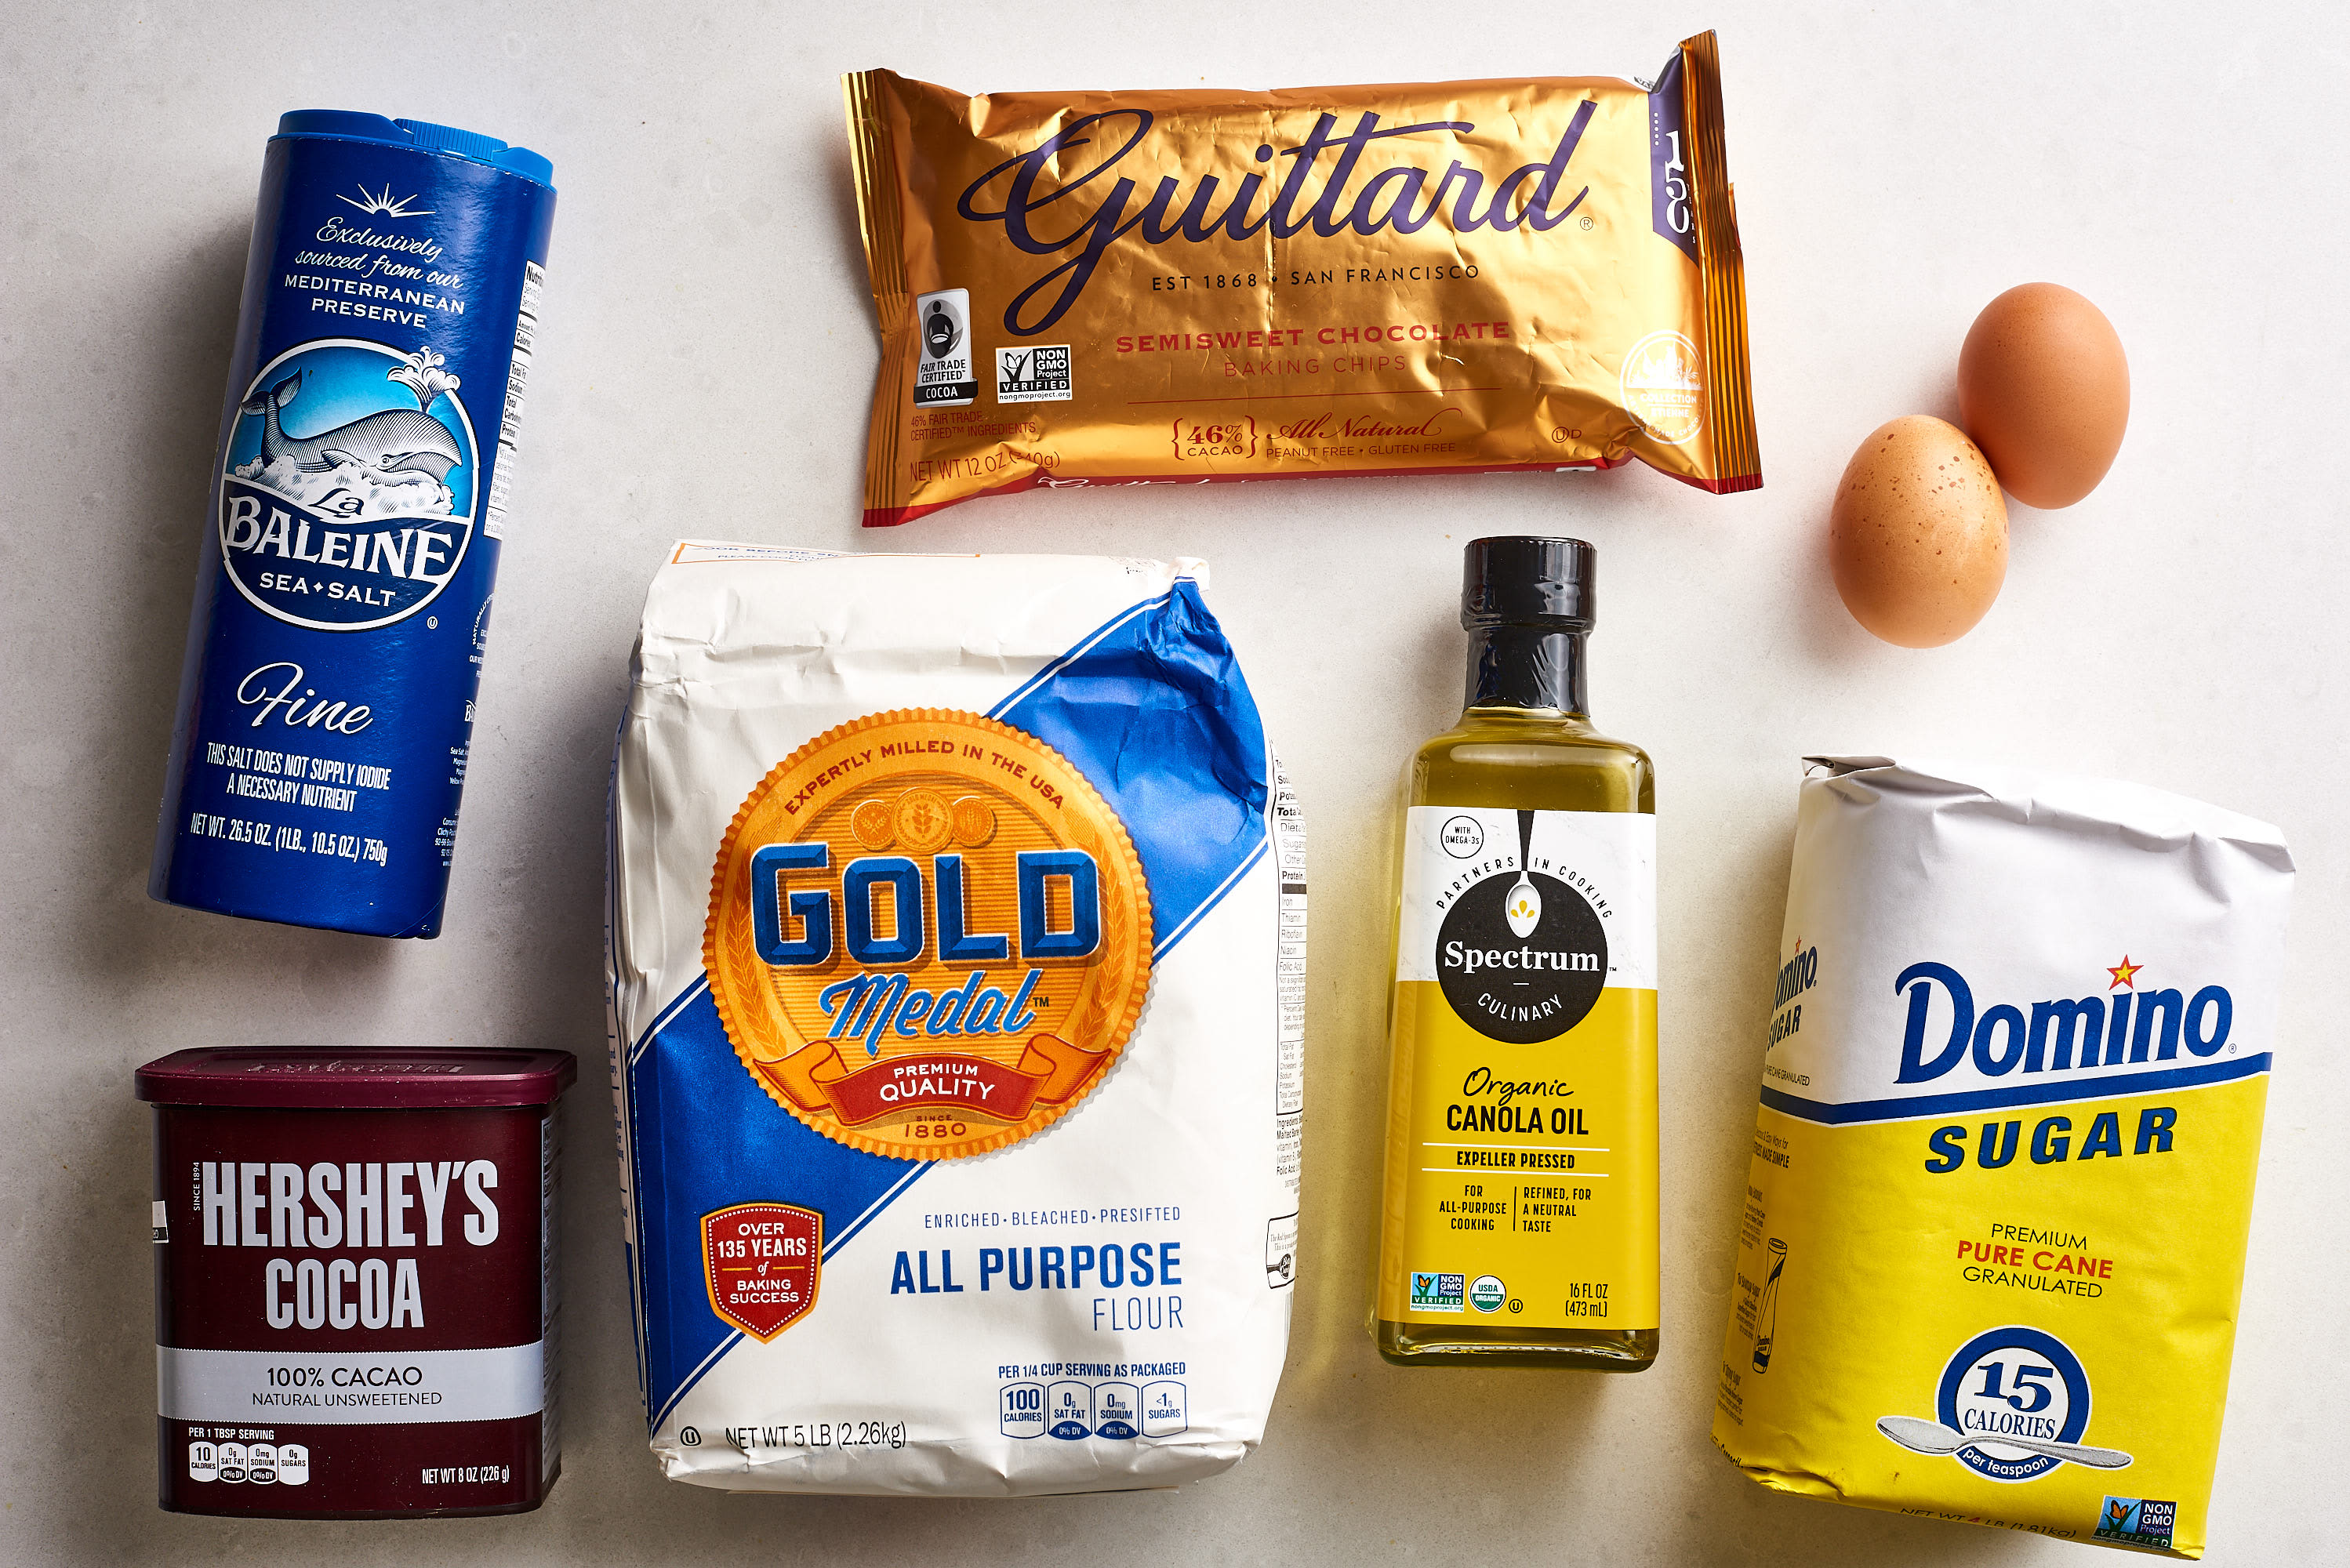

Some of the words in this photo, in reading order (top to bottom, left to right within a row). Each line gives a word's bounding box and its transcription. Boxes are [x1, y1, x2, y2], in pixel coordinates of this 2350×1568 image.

[957, 100, 1599, 337] Guittard
[316, 216, 443, 263] Exclusively
[295, 250, 368, 270] sourced
[361, 255, 424, 280] from
[427, 270, 463, 289] our
[1152, 276, 1190, 291] EST
[1204, 273, 1258, 289] 1868
[1291, 270, 1333, 285] SAN
[1347, 265, 1480, 283] FRANCISCO
[285, 274, 465, 314] MEDITERRANEAN
[311, 298, 427, 328] PRESERVE
[1117, 328, 1304, 353] SEMISWEET
[1317, 321, 1509, 345] CHOCOLATE
[1037, 350, 1066, 360] NON
[1037, 359, 1066, 370] GMO
[1225, 358, 1320, 377] BAKING
[1333, 355, 1405, 374] CHIPS
[1037, 369, 1066, 379] Project
[926, 387, 958, 399] COCOA
[999, 391, 1071, 401] nongmoproject.org
[1003, 380, 1067, 392] VERIFIED
[911, 415, 927, 426] 46%
[929, 414, 948, 426] FAIR
[950, 411, 983, 424] TRADE
[1266, 412, 1332, 440] All
[1318, 408, 1463, 439] Natural
[1187, 424, 1243, 445] 46%
[1187, 445, 1243, 457] CACAO
[1266, 448, 1318, 459] PEANUT
[1323, 447, 1355, 456] FREE
[1368, 444, 1419, 456] GLUTEN
[1424, 443, 1456, 452] FREE
[307, 488, 364, 518] La
[224, 495, 452, 585] BALEINE
[260, 572, 309, 593] SEA
[327, 582, 396, 607] SALT
[237, 662, 374, 735] Fine
[207, 742, 226, 765] THIS
[227, 745, 254, 770] SALT
[253, 750, 283, 775] DOES
[284, 753, 309, 779] NOT
[310, 757, 355, 785] SUPPLY
[355, 764, 391, 790] IODIDE
[784, 750, 872, 815] EXPERTLY
[880, 740, 954, 758] MILLED
[962, 740, 984, 760] IN
[992, 752, 1027, 779] THE
[1030, 775, 1063, 810] USA
[226, 772, 236, 794] A
[236, 774, 300, 804] NECESSARY
[300, 784, 358, 812] NUTRIENT
[191, 812, 207, 835] NET
[208, 815, 226, 839] WT.
[228, 818, 252, 843] 26.5
[254, 823, 272, 847] OZ.
[275, 826, 307, 853] (1LB.,
[311, 831, 337, 856] 10.5
[338, 834, 360, 862] OZ.)
[362, 837, 388, 867] 750g
[1445, 835, 1480, 844] OMEGA-3s
[1436, 856, 1514, 909] PARTNERS
[1535, 857, 1549, 869] IN
[1559, 866, 1612, 918] COOKING
[750, 842, 1102, 967] GOLD
[1444, 941, 1600, 974] Spectrum
[819, 968, 1043, 1058] Medal
[1477, 992, 1563, 1022] CULINARY
[1893, 961, 2233, 1084] Domino
[894, 1063, 978, 1078] PREMIUM
[880, 1077, 994, 1102] QUALITY
[1463, 1066, 1575, 1106] Organic
[905, 1122, 966, 1138] 1880
[1447, 1104, 1544, 1134] CANOLA
[1551, 1108, 1589, 1135] OIL
[1925, 1106, 2177, 1174] SUGAR
[1457, 1151, 1516, 1167] EXPELLER
[1520, 1152, 1575, 1169] PRESSED
[1464, 1185, 1483, 1197] FOR
[1524, 1186, 1569, 1200] REFINED,
[1573, 1189, 1591, 1200] FOR
[202, 1160, 499, 1248] HERSHEY'S
[1439, 1201, 1507, 1214] ALL-PURPOSE
[1533, 1203, 1577, 1217] NEUTRAL
[924, 1213, 999, 1229] ENRICHED
[1012, 1210, 1088, 1226] BLEACHED
[1100, 1207, 1181, 1223] PRESIFTED
[1451, 1218, 1495, 1231] COOKING
[1523, 1220, 1552, 1232] TASTE
[738, 1223, 784, 1236] OVER
[1992, 1223, 2087, 1250] PREMIUM
[717, 1240, 745, 1258] 135
[751, 1237, 807, 1257] YEARS
[757, 1261, 769, 1276] of
[890, 1249, 964, 1294] ALL
[979, 1242, 1182, 1292] PURPOSE
[1957, 1240, 2025, 1267] PURE
[2032, 1250, 2113, 1279] CANE
[737, 1279, 791, 1291] BAKING
[1569, 1283, 1579, 1298] 16
[1582, 1283, 1593, 1299] FL
[1596, 1283, 1609, 1299] OZ
[1963, 1266, 2102, 1298] GRANULATED
[266, 1258, 424, 1329] COCOA
[729, 1292, 799, 1304] SUCCESS
[1093, 1295, 1183, 1332] FLOUR
[1565, 1301, 1588, 1317] (473
[1589, 1302, 1607, 1318] mL)
[267, 1367, 325, 1387] 100%
[331, 1366, 423, 1387] CACAO
[998, 1365, 1019, 1379] PER
[1022, 1364, 1038, 1377] 1/4
[1041, 1363, 1062, 1377] CUP
[1066, 1363, 1111, 1377] SERVING
[1114, 1363, 1128, 1377] AS
[1131, 1362, 1186, 1377] PACKAGED
[1974, 1361, 2054, 1413] 15
[252, 1392, 321, 1407] NATURAL
[325, 1392, 441, 1406] UNSWEETENED
[1006, 1388, 1040, 1410] 100
[1004, 1412, 1042, 1422] CALORIES
[1100, 1409, 1133, 1419] SODIUM
[1148, 1408, 1180, 1419] SUGARS
[1964, 1408, 2056, 1440] CALORIES
[725, 1426, 757, 1449] NET
[762, 1425, 788, 1448] WT
[794, 1425, 805, 1446] 5
[810, 1424, 831, 1447] LB
[837, 1421, 906, 1450] (2.26kg)
[196, 1446, 211, 1461] 10
[1963, 1448, 1986, 1468] per
[1987, 1457, 2049, 1477] teaspoon
[2142, 1514, 2172, 1526] GMO
[2145, 1503, 2173, 1515] NON
[2101, 1530, 2169, 1547] VERIFIED
[2140, 1524, 2170, 1536] Project
